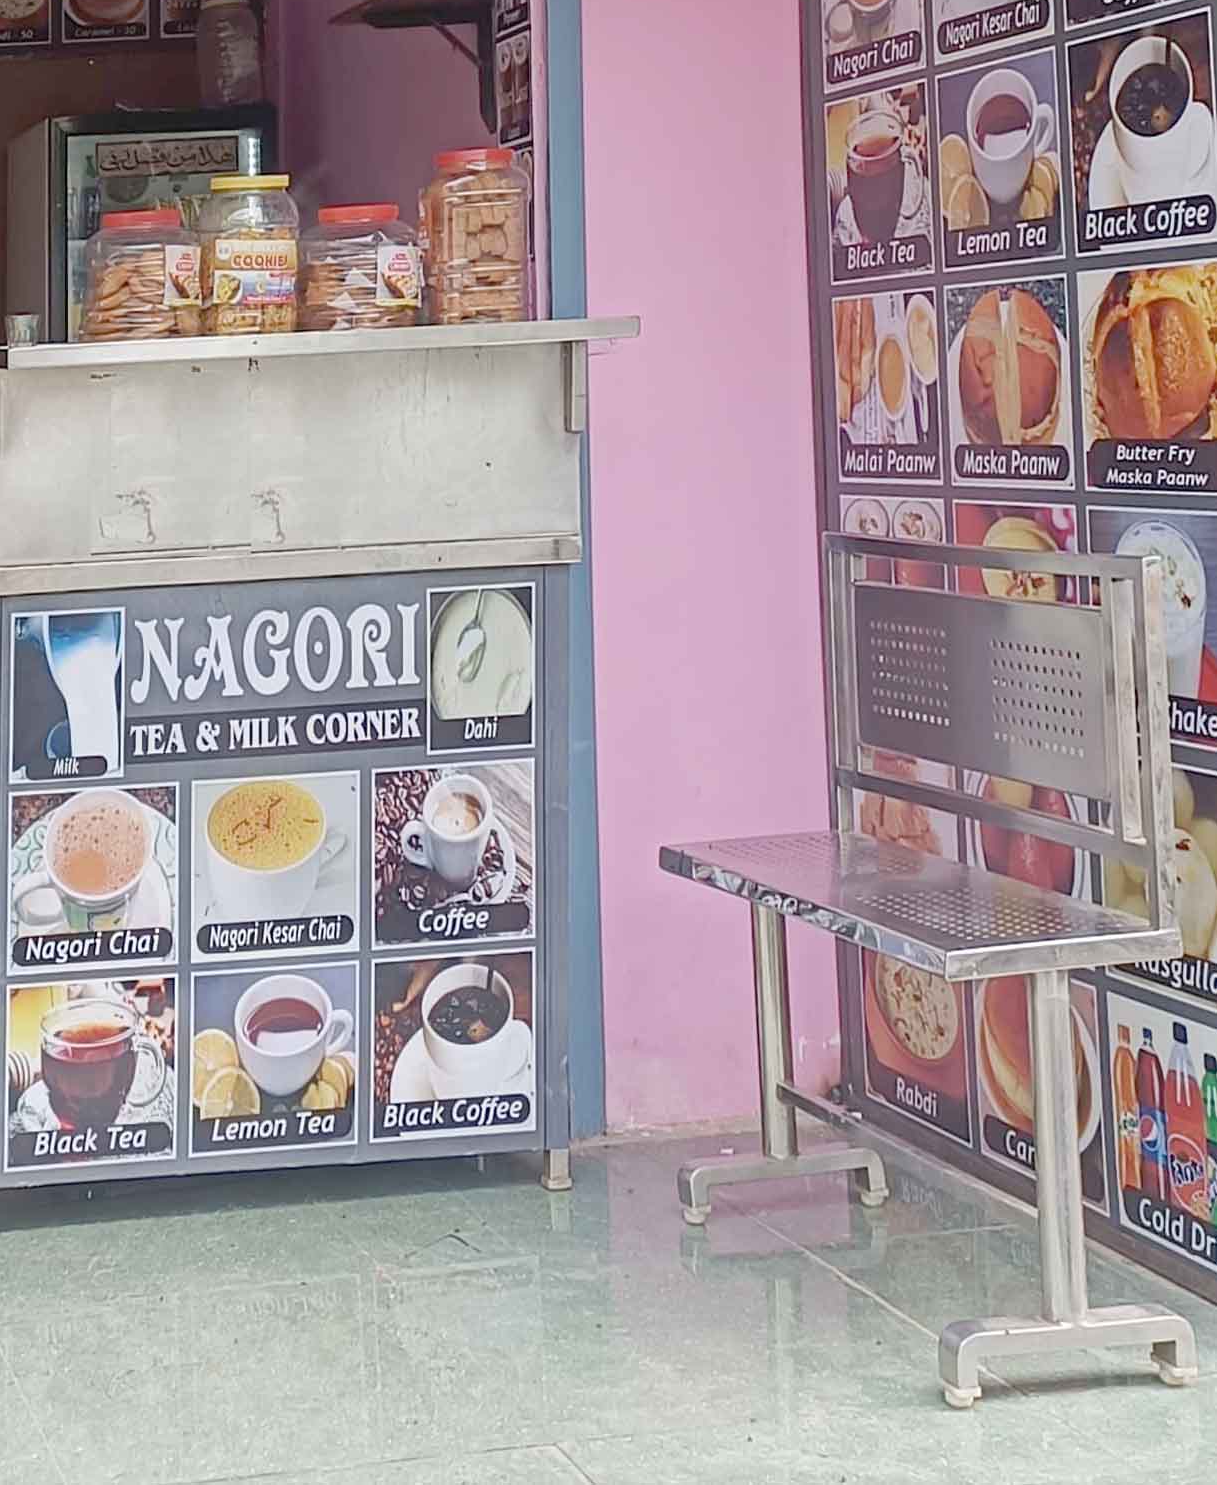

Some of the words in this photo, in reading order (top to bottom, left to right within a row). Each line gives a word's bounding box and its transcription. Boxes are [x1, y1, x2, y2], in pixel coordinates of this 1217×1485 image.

[945, 16, 982, 49] Nagori
[983, 10, 1014, 39] Kesar
[1015, 2, 1041, 30] Chai
[833, 45, 879, 77] Nagori
[881, 39, 915, 63] Chai
[1085, 212, 1137, 241] Black
[1144, 202, 1211, 234] Coffee
[846, 246, 885, 270] Black
[890, 241, 916, 264] Tea
[958, 229, 1010, 256] Lemon
[1016, 223, 1047, 248] Tea
[845, 447, 883, 473] Malai
[886, 450, 937, 474] Paanw
[963, 451, 1007, 475] Maska
[1010, 452, 1060, 476] Paanw
[1116, 445, 1166, 462] Butter
[1171, 445, 1196, 465] Fry
[1106, 468, 1153, 485] Maska
[1156, 469, 1209, 487] Paanw
[130, 602, 421, 704] NAGORI
[130, 723, 187, 756] TEA
[196, 720, 220, 751] &
[229, 715, 299, 750] MILK
[306, 707, 422, 745] CORNER
[464, 717, 499, 741] Dahi
[1171, 701, 1217, 738] hake
[53, 756, 80, 775] Milk
[209, 922, 259, 952] Nagori
[262, 921, 305, 944] Kesar
[308, 916, 341, 941] Chai
[418, 907, 489, 937] Coffee
[25, 932, 102, 963] Nagori
[109, 928, 160, 955] Chai
[383, 1101, 444, 1128] Black
[452, 1098, 523, 1125] Coffee
[895, 1076, 938, 1118] Rabdi
[34, 1127, 98, 1157] Black
[107, 1125, 147, 1151] Tea
[211, 1116, 287, 1143] Lemon
[296, 1111, 335, 1135] Tea
[1139, 1198, 1184, 1242] Cold
